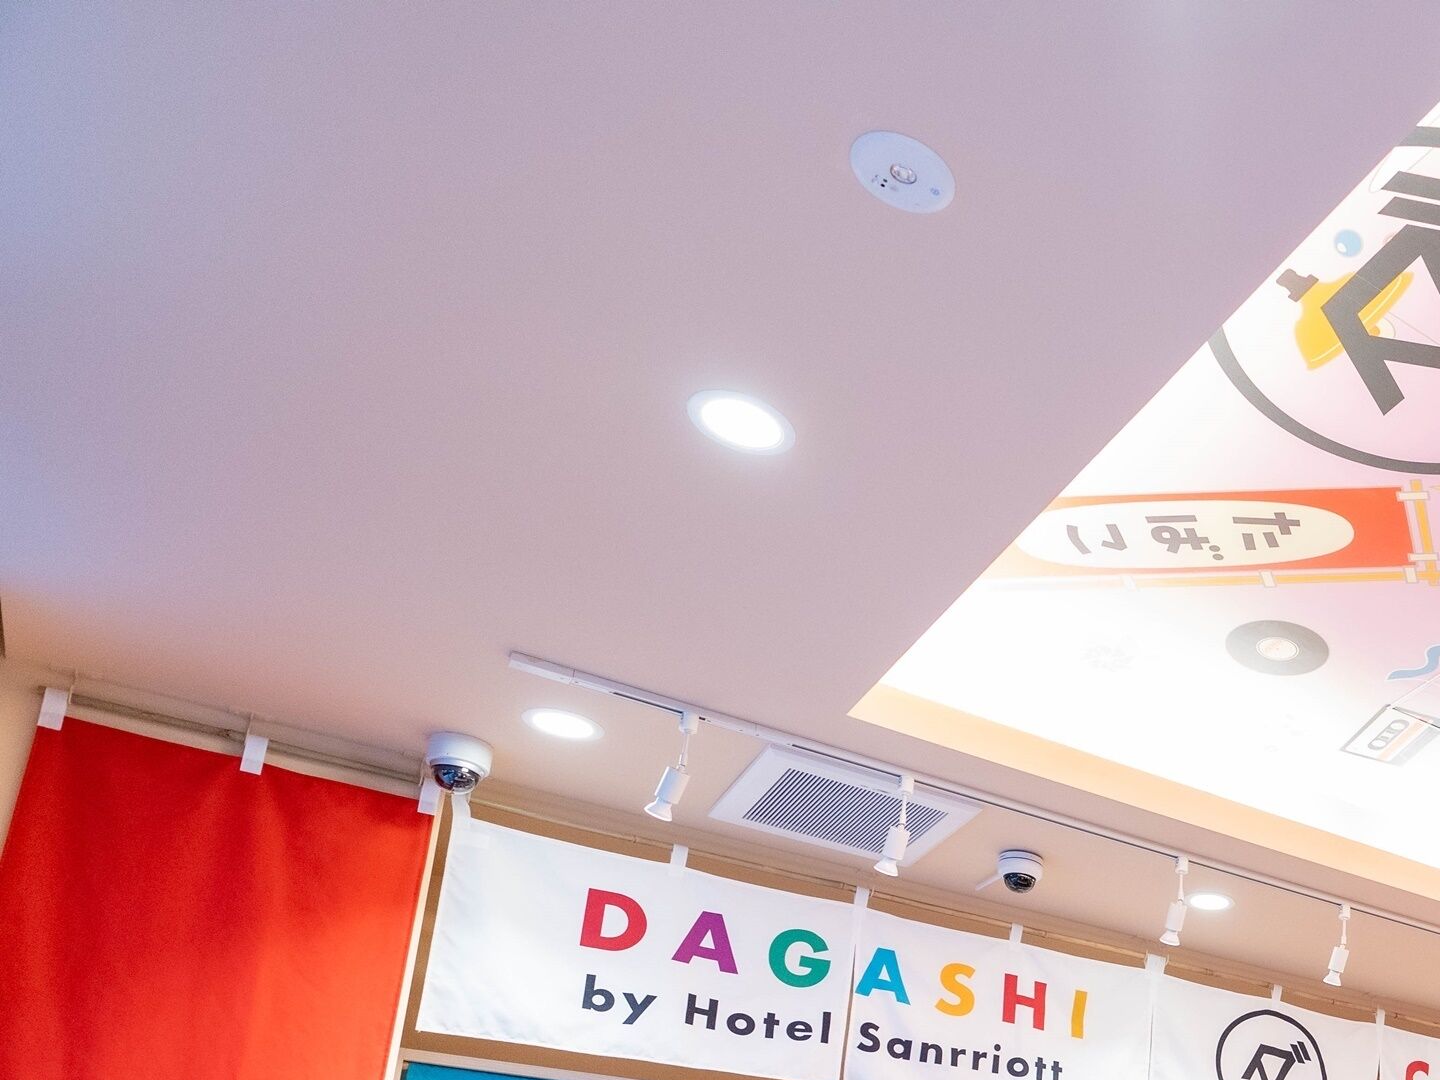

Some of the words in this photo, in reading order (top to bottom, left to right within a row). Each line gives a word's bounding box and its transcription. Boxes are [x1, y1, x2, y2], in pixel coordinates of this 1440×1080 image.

[580, 888, 1087, 1039] DAGASHI
[582, 974, 657, 1024] by
[685, 993, 831, 1044] Hotel
